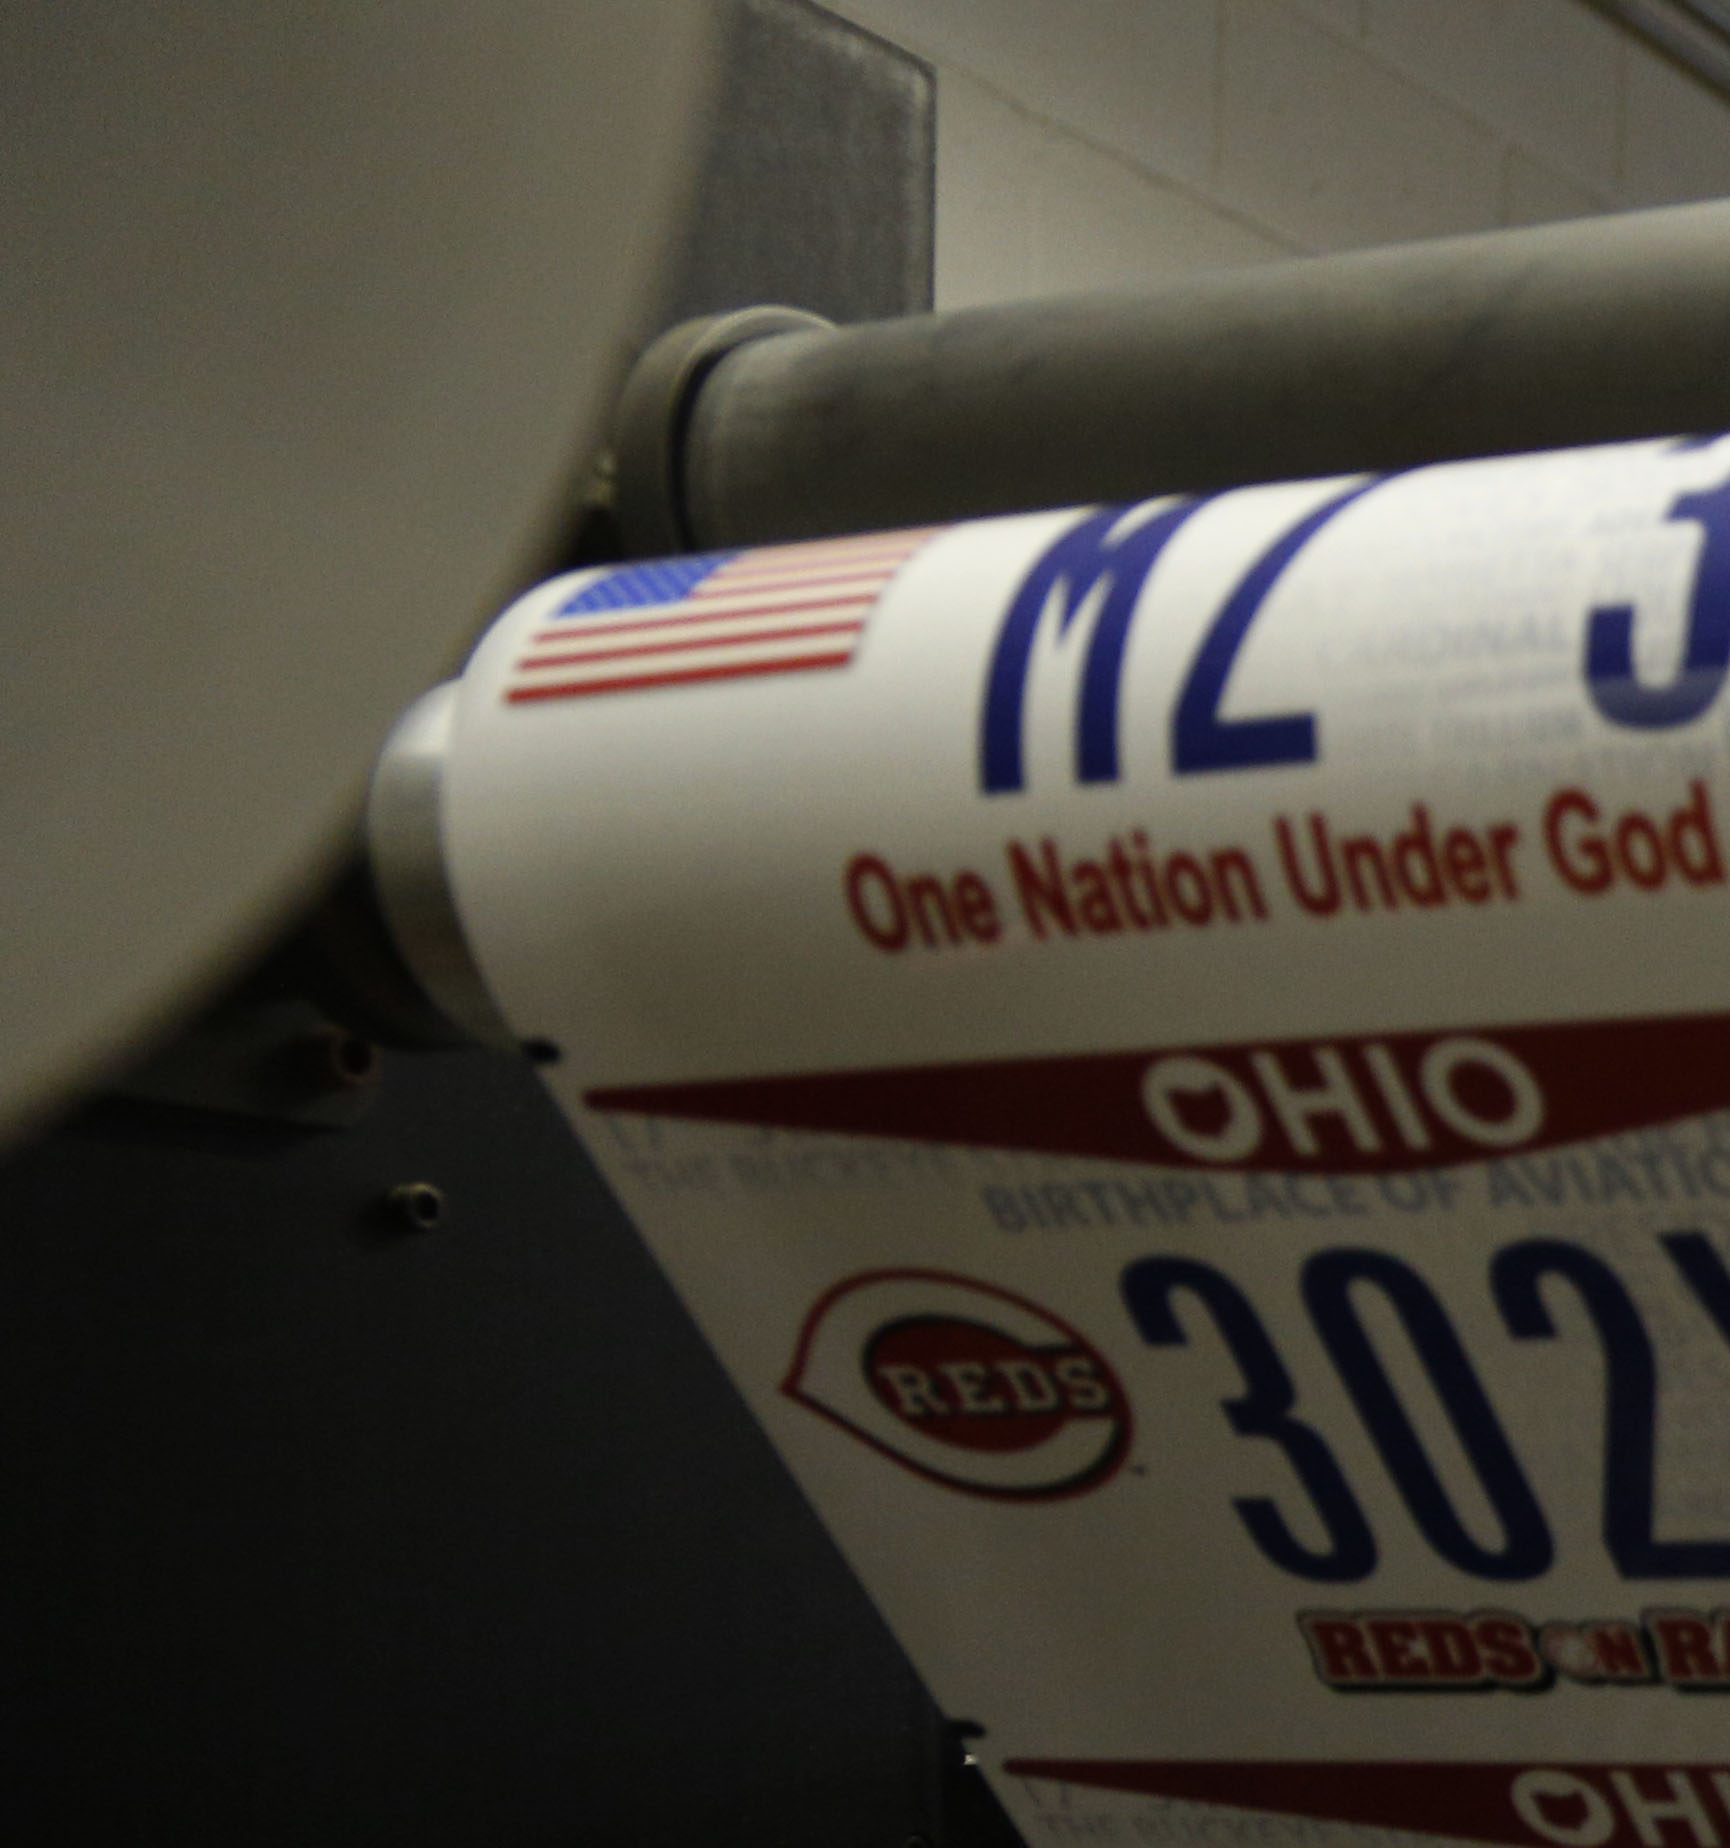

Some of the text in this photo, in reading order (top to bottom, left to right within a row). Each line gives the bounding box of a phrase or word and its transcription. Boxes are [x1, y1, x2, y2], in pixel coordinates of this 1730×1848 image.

[844, 779, 1728, 953] One Nation Under God
[1141, 1034, 1542, 1160] OHIO
[978, 1171, 1370, 1229] BIRTHPLACE
[1386, 1173, 1468, 1210] OF
[882, 1360, 1114, 1413] REDS
[1309, 1615, 1542, 1681] REDS
